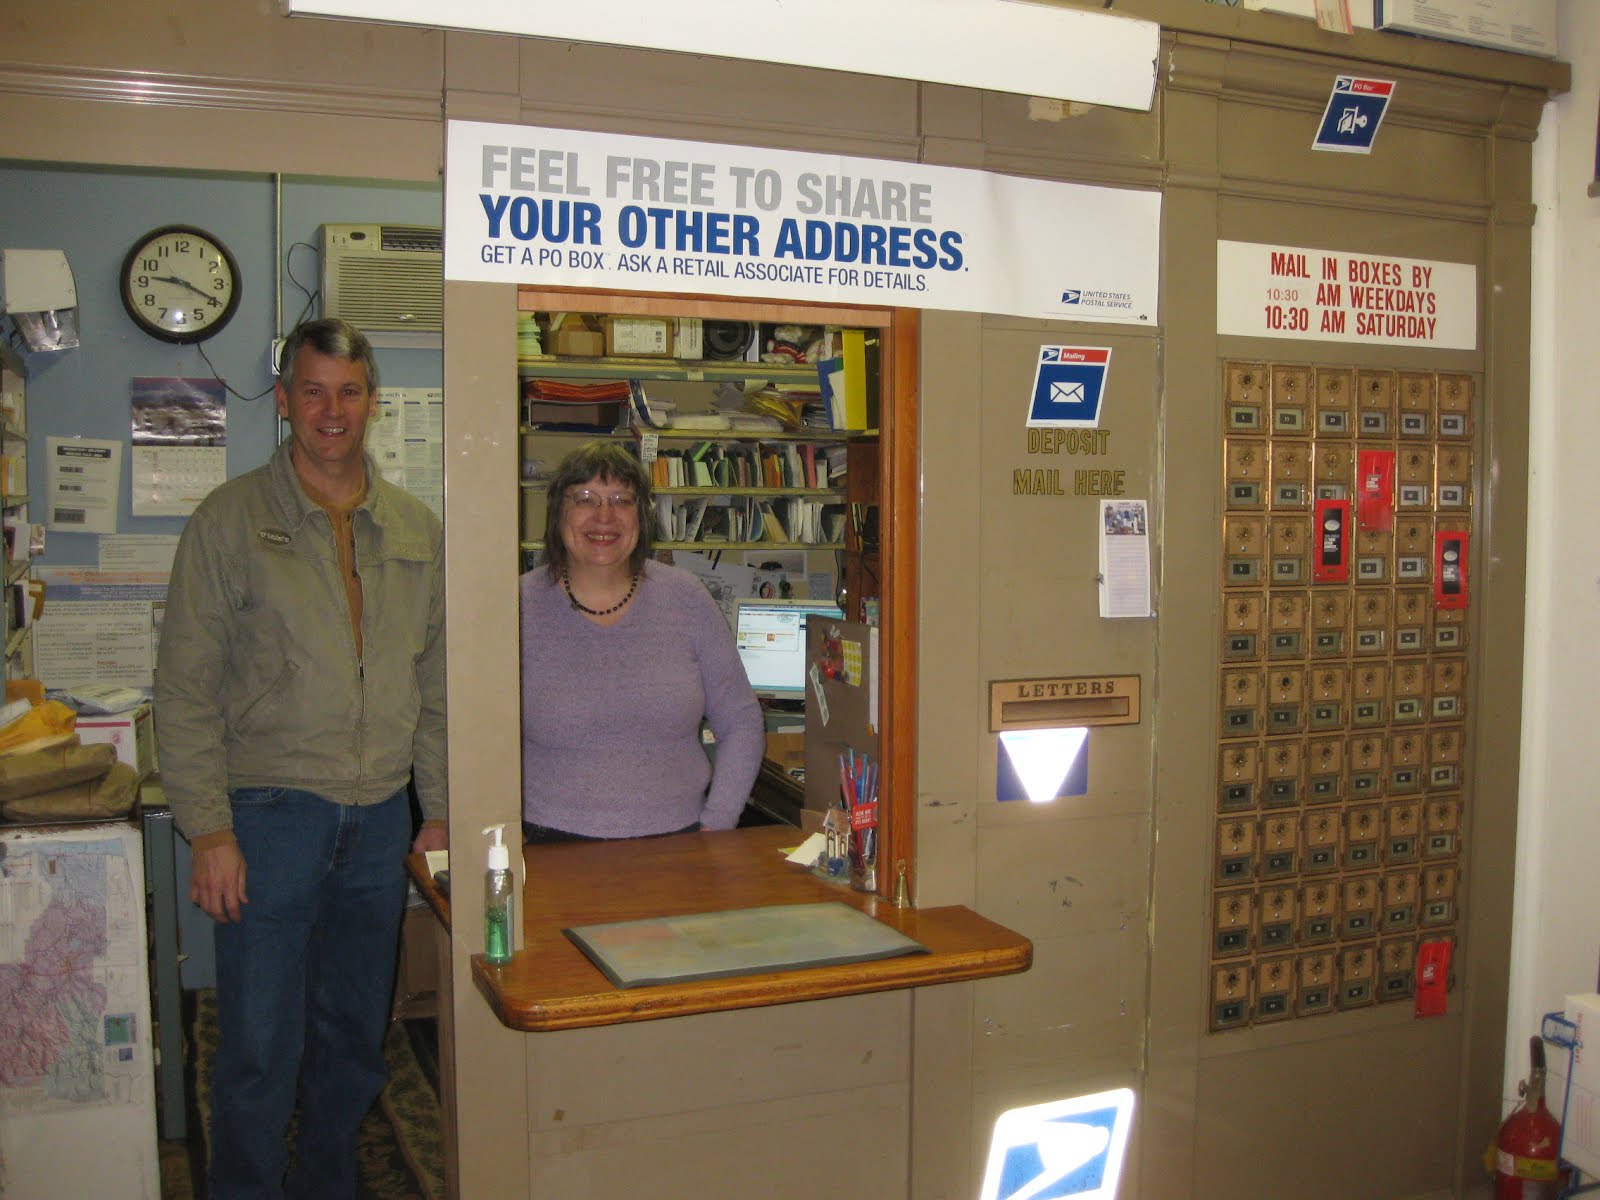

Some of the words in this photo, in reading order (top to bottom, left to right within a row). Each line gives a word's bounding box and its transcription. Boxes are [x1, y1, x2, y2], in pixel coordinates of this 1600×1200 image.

[482, 145, 591, 196] FEEL
[606, 155, 715, 206] FREE
[730, 167, 782, 211] TO
[796, 172, 932, 224] SHARE
[479, 194, 602, 246] YOUR
[618, 205, 760, 257] OTHER
[158, 246, 169, 258] 11
[175, 241, 190, 253] 12
[199, 247, 204, 259] 1
[143, 259, 159, 271] 10
[208, 261, 219, 273] 2
[481, 244, 516, 265] GET
[521, 247, 533, 266] A
[539, 249, 562, 267] PO
[617, 254, 651, 273] ASK
[656, 256, 668, 274] A
[673, 258, 729, 279] RETAIL
[734, 262, 823, 284] ASSOCIATE
[828, 268, 859, 287] FOR
[864, 271, 930, 292] DETAILS.
[1271, 252, 1310, 279] MAIL
[1322, 257, 1337, 281] IN
[1349, 259, 1402, 287] BOXES
[1412, 265, 1432, 289] BY
[138, 275, 149, 288] 9
[213, 278, 224, 290] 3
[144, 294, 155, 306] 8
[1082, 290, 1108, 299] UNITED
[1109, 292, 1131, 300] STATES
[1266, 288, 1299, 302] 10:30
[1316, 283, 1341, 307] AM
[1350, 285, 1436, 315] WEEKDAYS
[1081, 299, 1105, 307] POSTAL
[1106, 300, 1132, 309] SERVICE
[158, 307, 168, 319] 7
[193, 308, 204, 320] 5
[1265, 305, 1309, 332] 10:30
[1320, 310, 1345, 334] AM
[1356, 312, 1437, 340] SATURDAY
[1063, 352, 1086, 361] Mailing
[1027, 428, 1110, 455] DEPOSIT
[1013, 469, 1064, 495] MAIL
[1074, 470, 1126, 496] HERE
[1018, 681, 1115, 698] LETTERS
